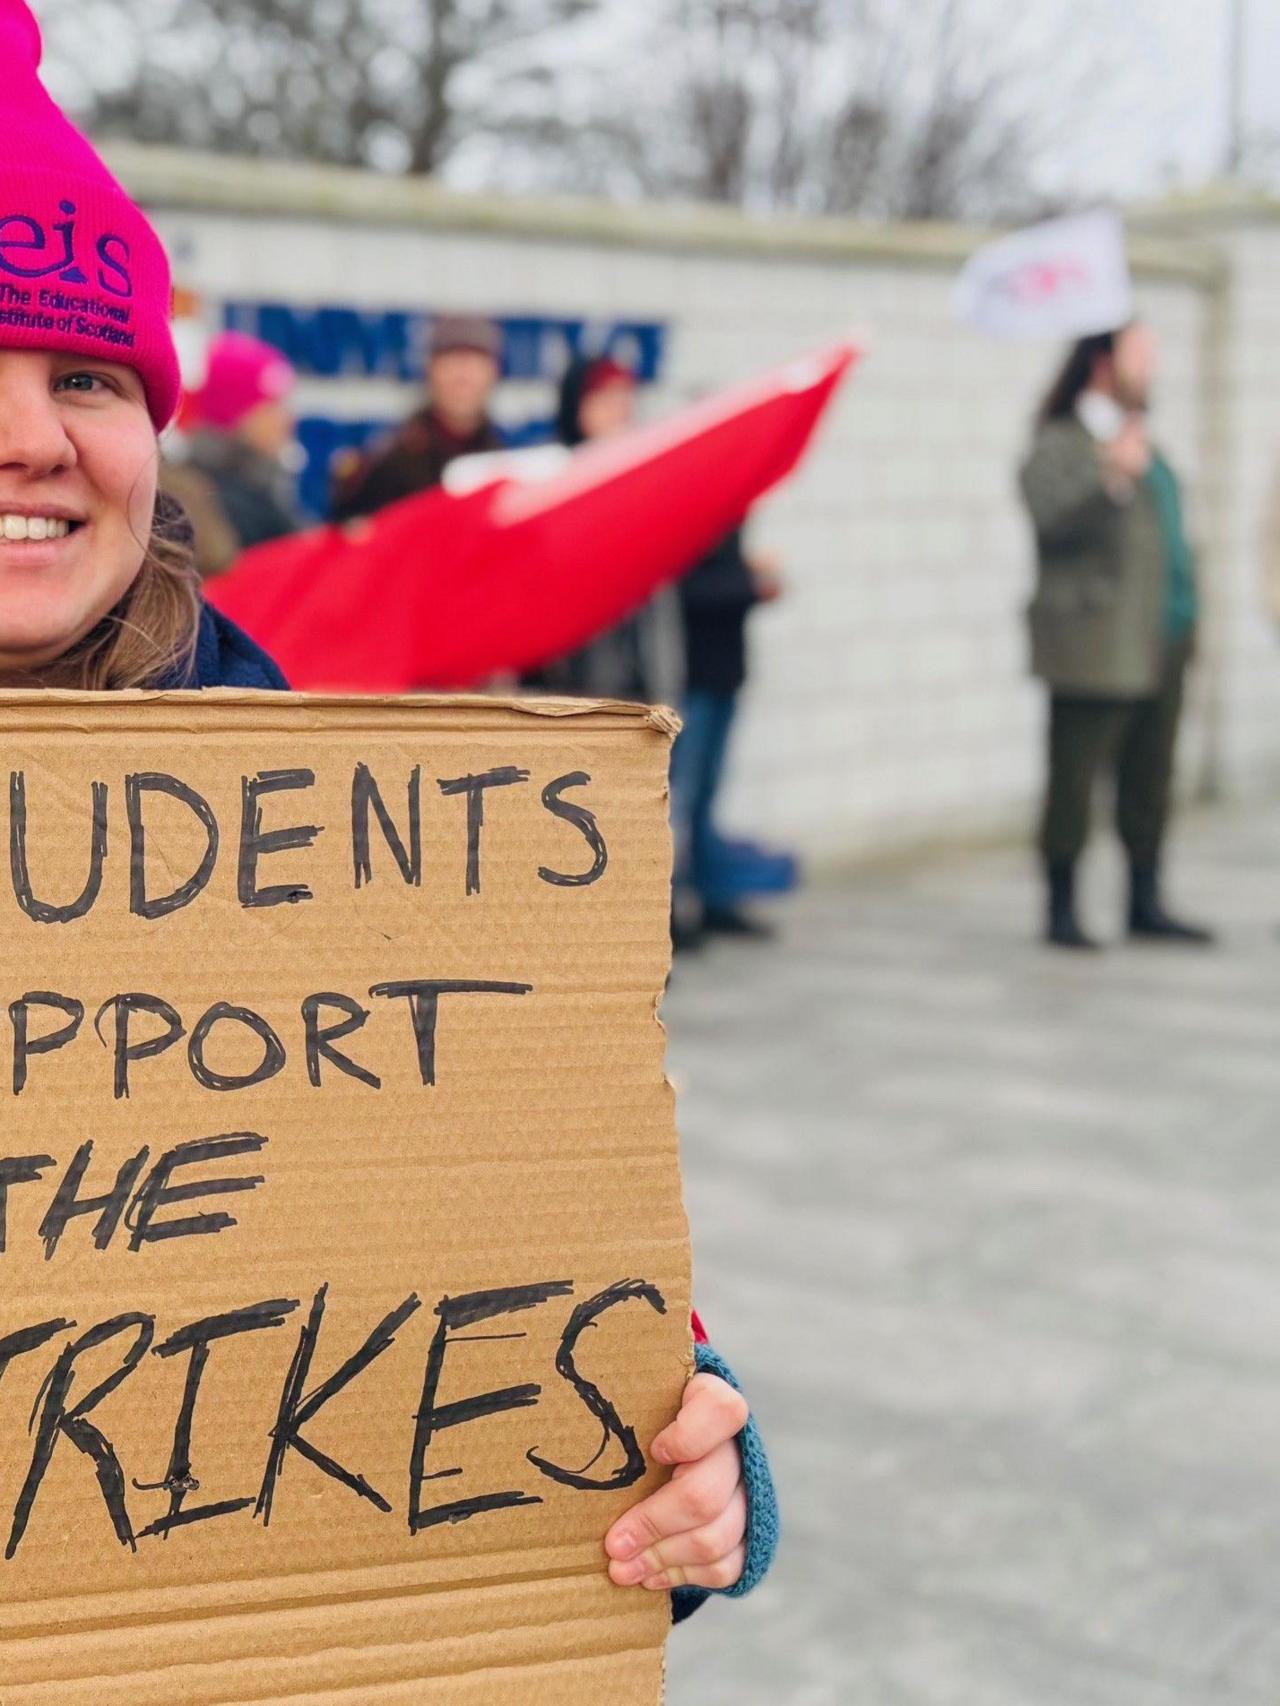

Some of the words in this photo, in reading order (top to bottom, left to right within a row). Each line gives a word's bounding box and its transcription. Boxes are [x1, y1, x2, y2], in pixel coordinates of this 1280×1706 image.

[38, 287, 130, 325] Educational
[56, 315, 72, 334] of
[75, 316, 135, 348] Scotland
